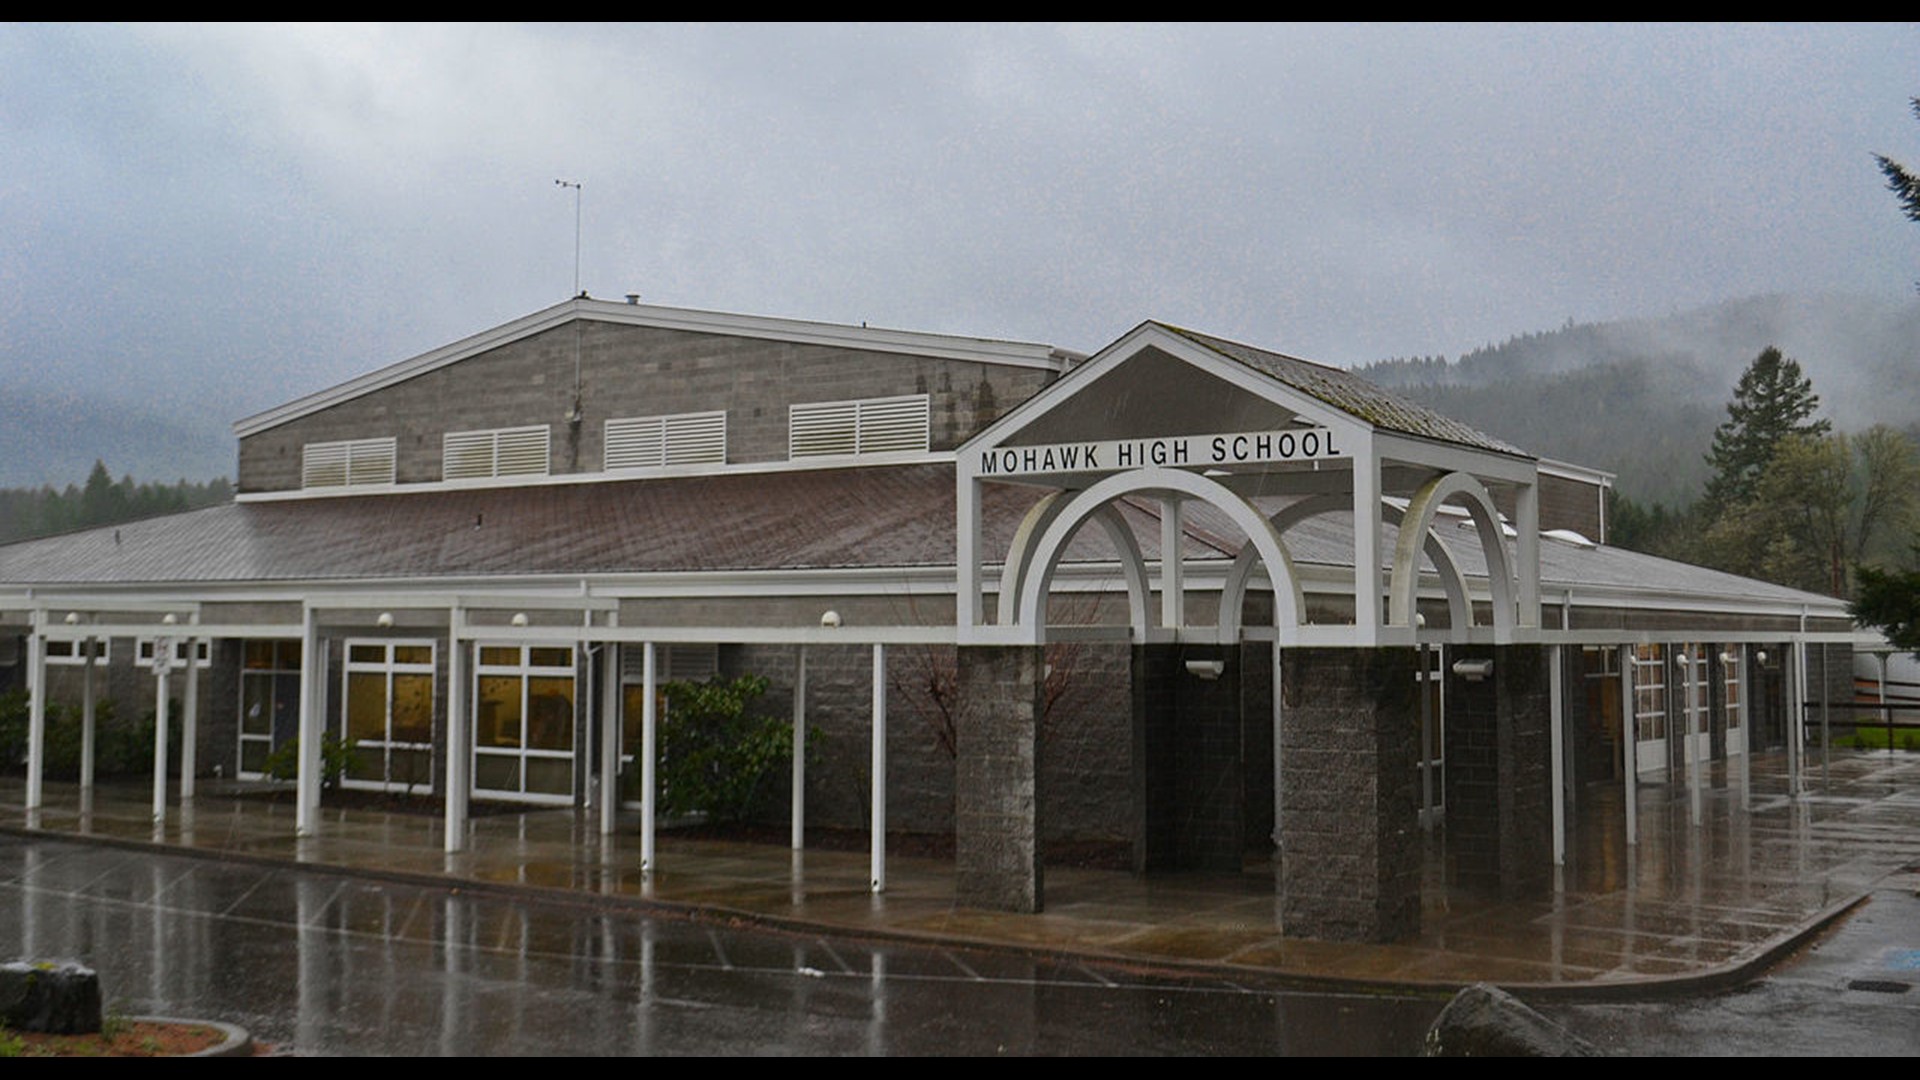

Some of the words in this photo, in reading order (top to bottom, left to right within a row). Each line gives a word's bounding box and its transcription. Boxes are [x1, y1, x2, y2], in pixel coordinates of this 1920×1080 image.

[981, 446, 1098, 474] MOHAWK
[1118, 440, 1188, 466] HIGH
[1212, 432, 1340, 462] SCHOOL
